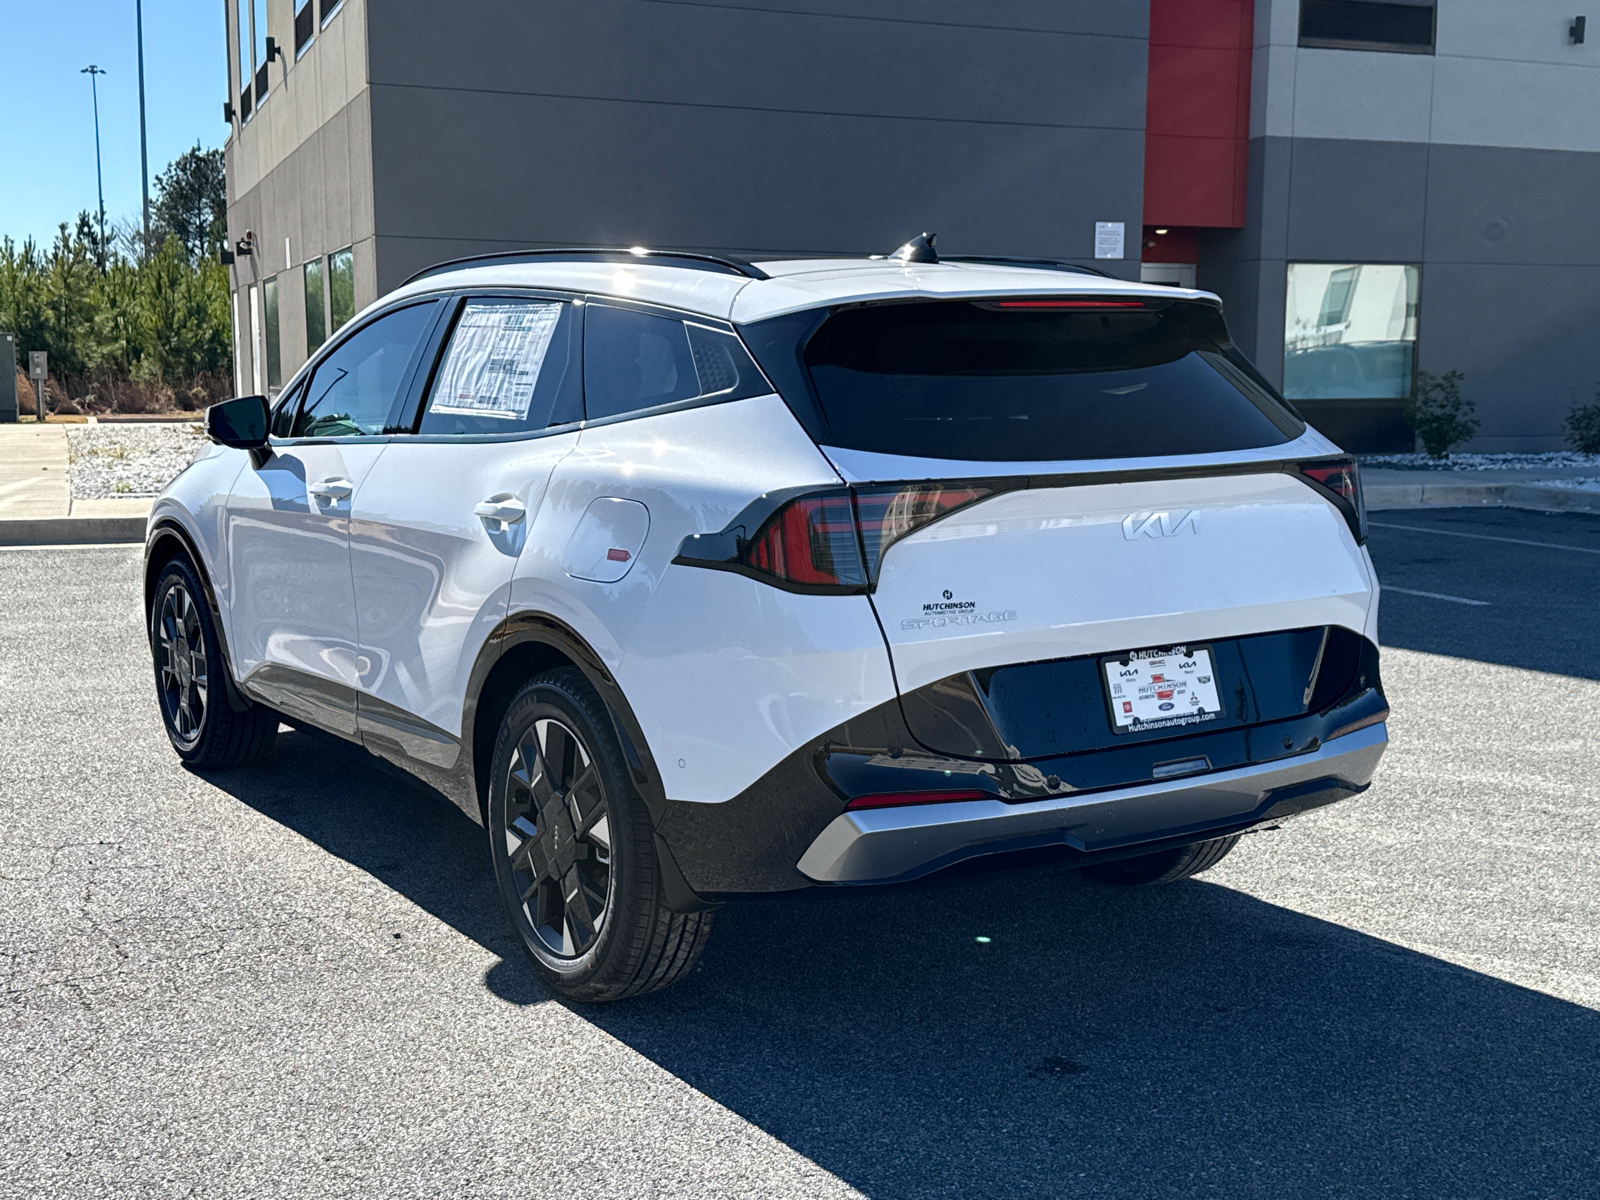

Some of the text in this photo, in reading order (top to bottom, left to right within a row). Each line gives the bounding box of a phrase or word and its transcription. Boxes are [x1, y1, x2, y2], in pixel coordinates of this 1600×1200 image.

[1121, 509, 1202, 541] KIA
[922, 601, 976, 611] HUTCHINSON
[901, 610, 1018, 630] SPORTAGE
[1179, 661, 1197, 669] KIA
[1120, 669, 1138, 677] KIA
[1128, 713, 1216, 732] Hutchinsonautogroup.com
